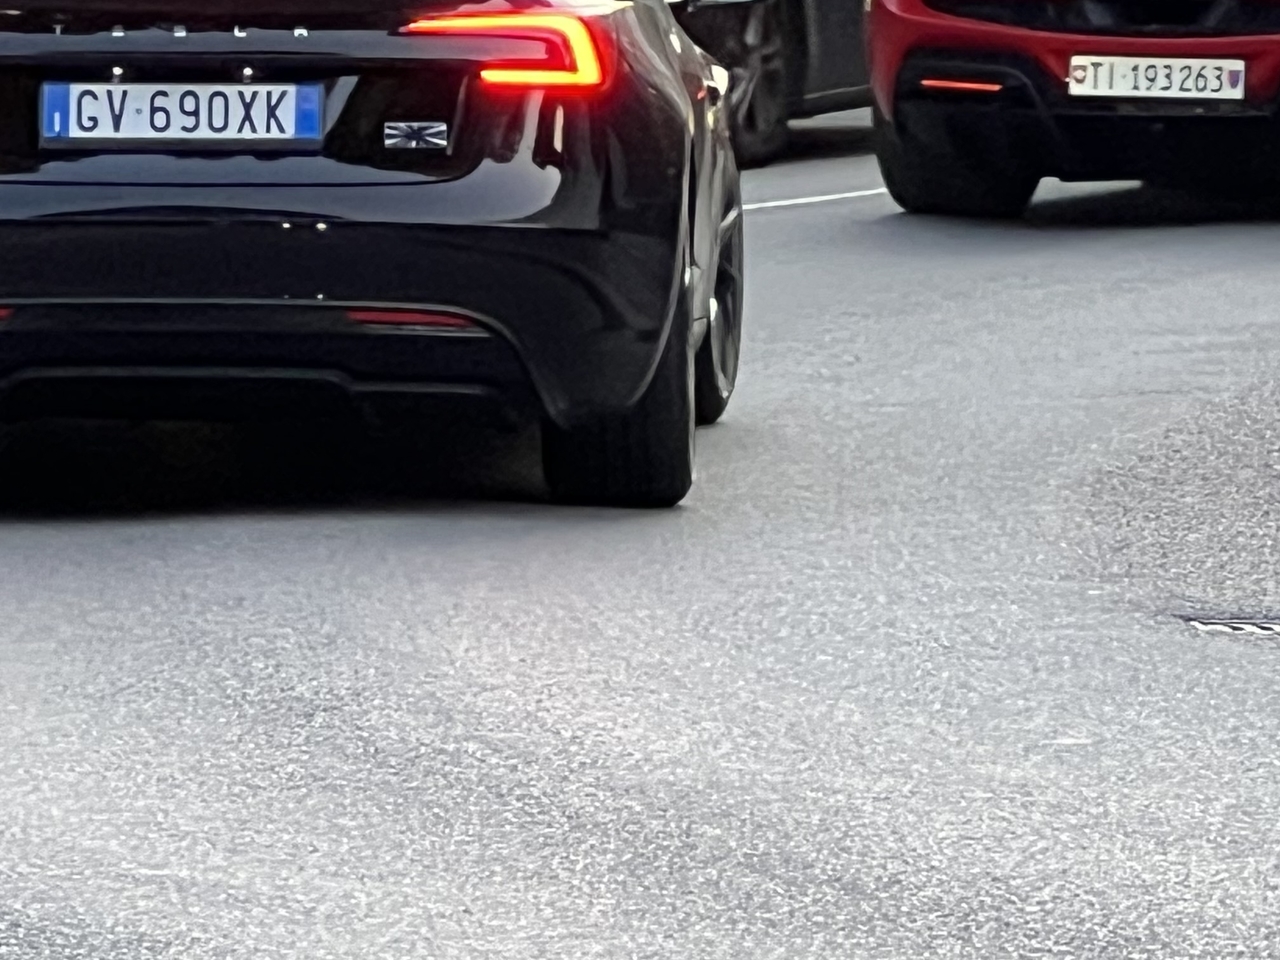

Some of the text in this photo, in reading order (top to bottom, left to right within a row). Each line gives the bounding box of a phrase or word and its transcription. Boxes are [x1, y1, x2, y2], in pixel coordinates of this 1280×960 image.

[1090, 61, 1224, 93] TI 193263
[76, 89, 289, 133] GV 690XK
